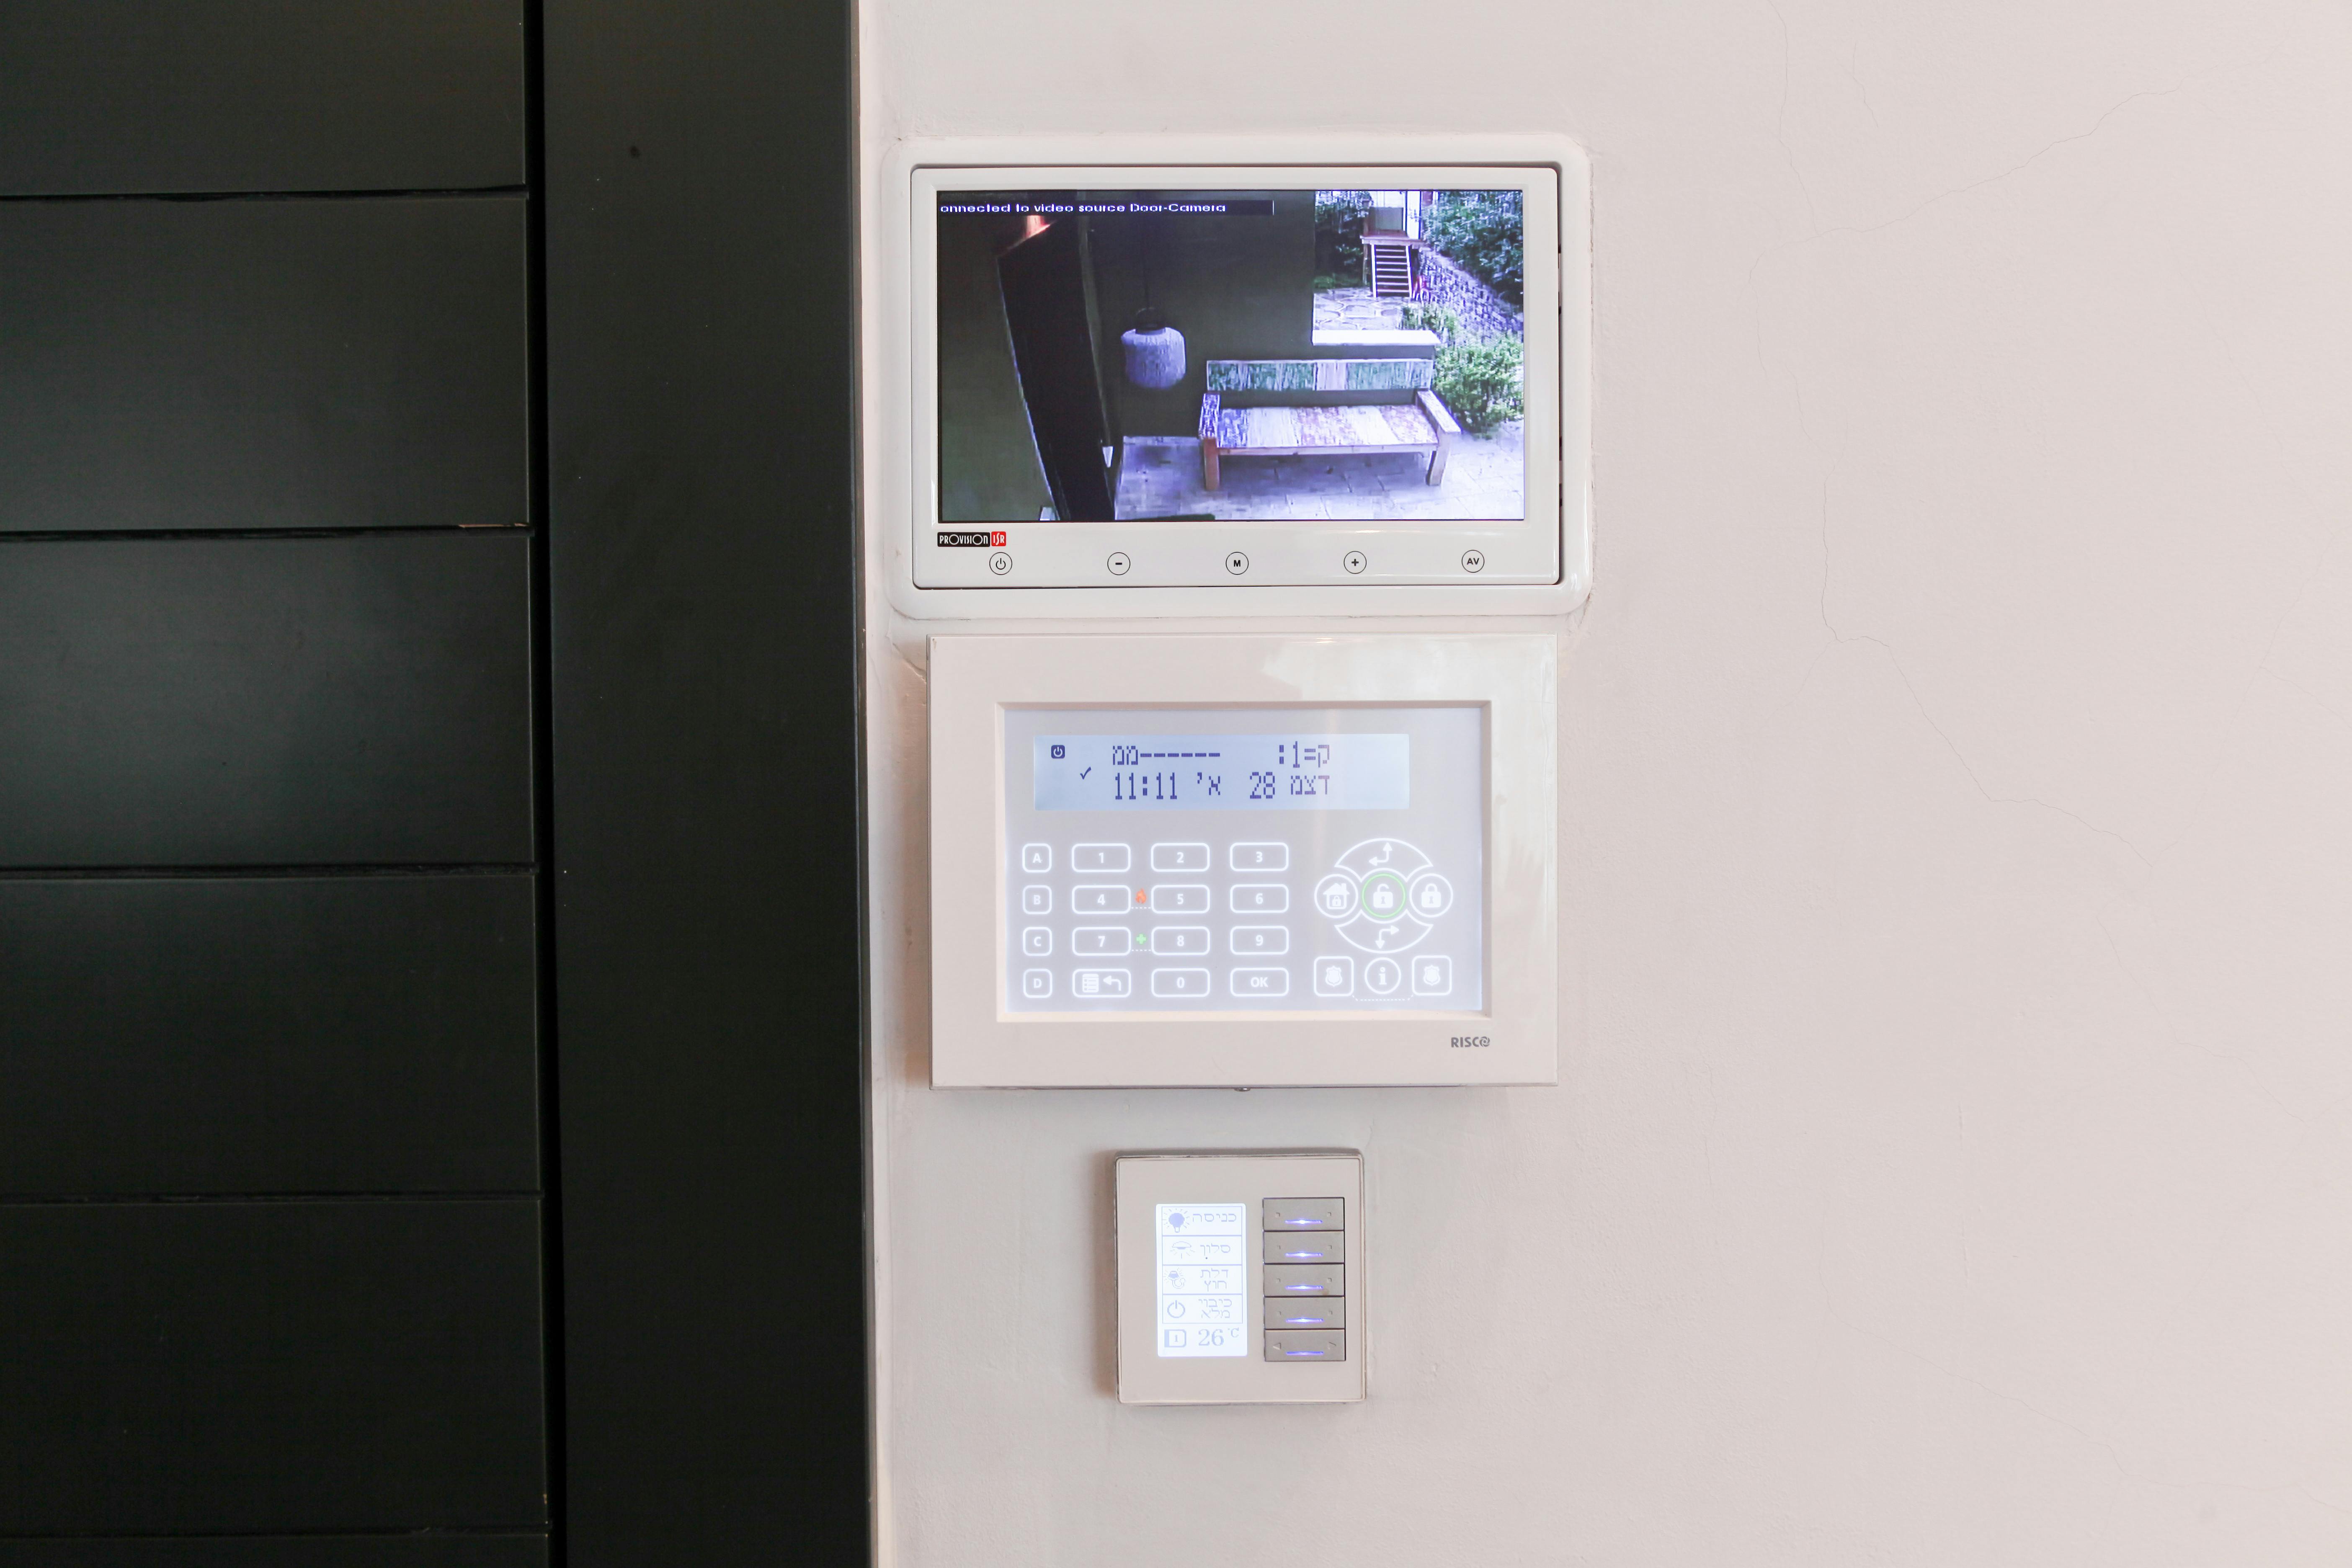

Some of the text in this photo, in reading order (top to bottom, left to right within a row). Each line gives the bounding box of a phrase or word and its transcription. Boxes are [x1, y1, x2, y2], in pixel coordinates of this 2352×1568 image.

[1016, 204, 1029, 213] to
[1034, 204, 1074, 213] video
[1130, 203, 1226, 212] Door-Camera
[993, 532, 1005, 546] ISR
[1115, 772, 1177, 800] 11:11
[1250, 771, 1275, 799] 28
[1033, 853, 1042, 863] A
[1177, 852, 1184, 863] 2
[1256, 851, 1263, 862] 3
[1034, 895, 1041, 905] B
[1097, 894, 1106, 905] 4
[1177, 893, 1184, 905] 5
[1256, 893, 1264, 905] 6
[1034, 936, 1041, 947] C
[1098, 936, 1105, 947] 7
[1177, 935, 1184, 946] 8
[1256, 934, 1264, 946] 9
[1034, 978, 1042, 988] D
[1176, 977, 1185, 989] 0
[1251, 977, 1268, 988] OK
[1192, 1213, 1237, 1222] כניסה
[1200, 1268, 1229, 1278] דלת
[1204, 1281, 1227, 1292] חוץ
[1198, 1299, 1232, 1307] כיבוי
[1201, 1308, 1230, 1319] מלא
[1198, 1328, 1224, 1346] 26
